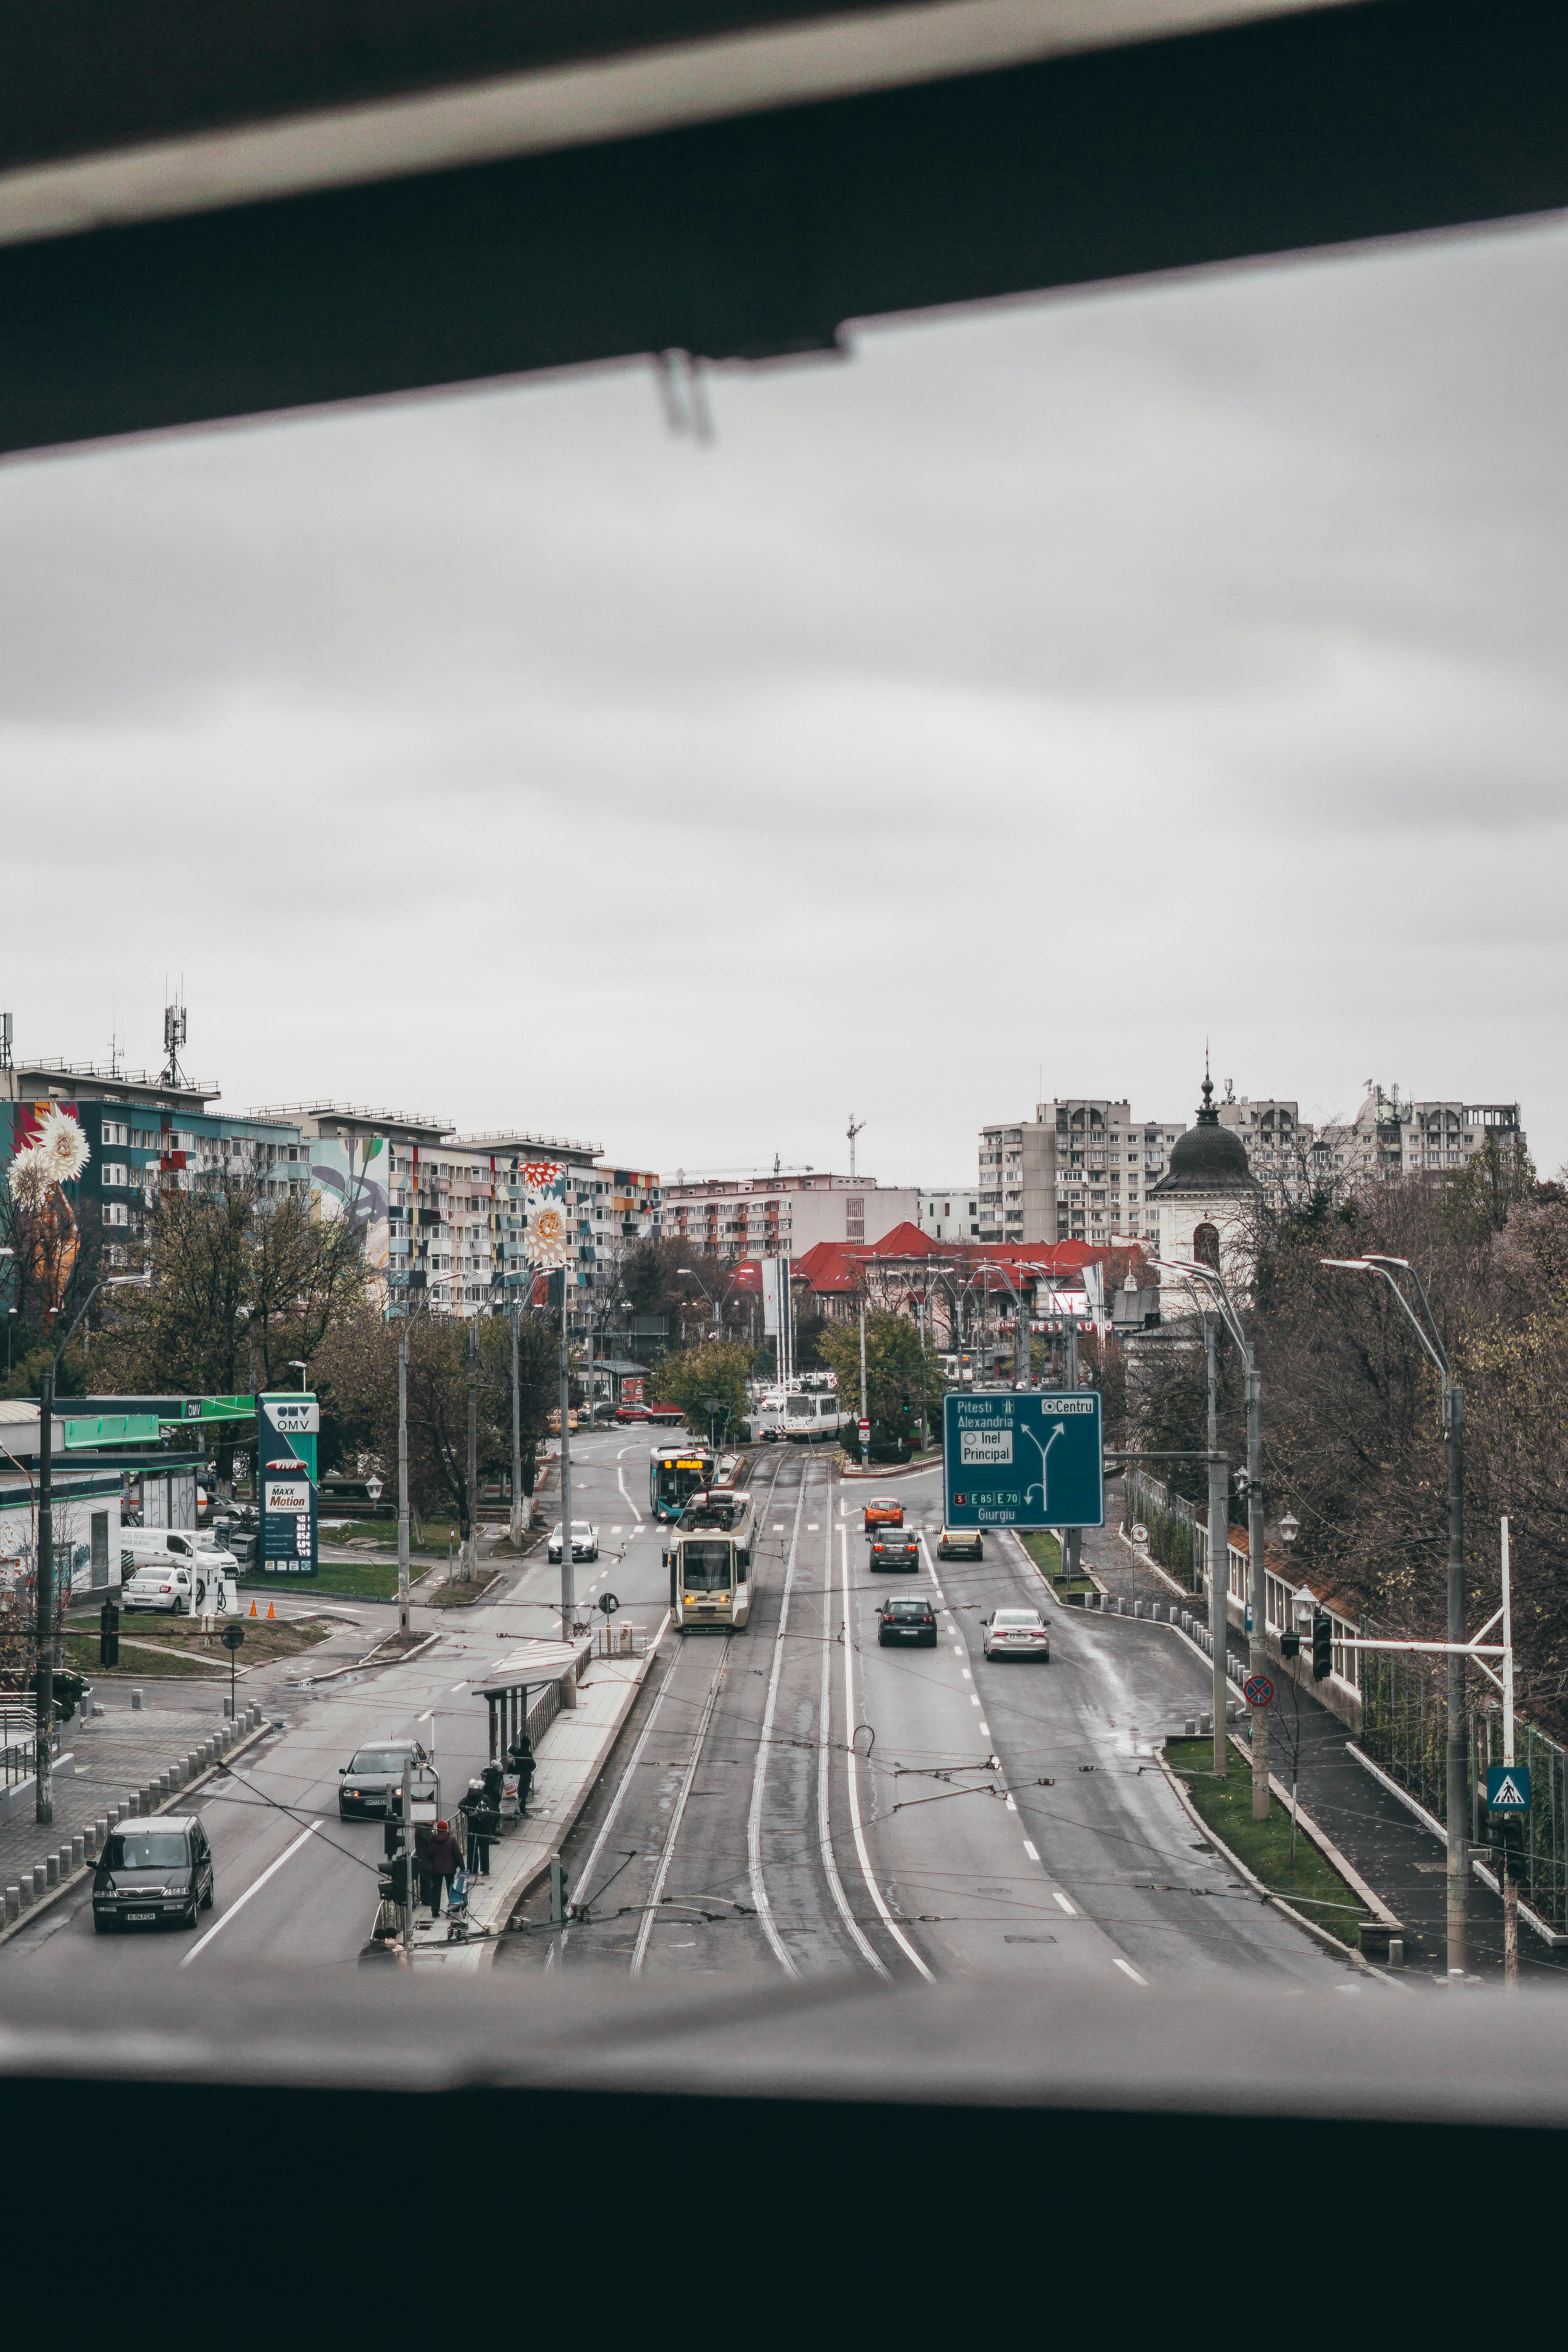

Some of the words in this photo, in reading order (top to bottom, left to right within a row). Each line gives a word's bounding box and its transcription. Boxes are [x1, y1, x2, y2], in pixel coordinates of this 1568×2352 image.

[189, 1404, 200, 1416] OMV
[1056, 1400, 1091, 1412] Centru
[278, 1420, 309, 1430] OMV
[958, 1415, 1013, 1428] Alexandria
[982, 1432, 1000, 1443] Inel
[964, 1447, 1009, 1462] Principal
[276, 1461, 298, 1469] VIVA
[270, 1496, 305, 1506] Motion
[972, 1494, 977, 1504] E
[981, 1494, 991, 1503] 85
[998, 1494, 1003, 1503] E
[1007, 1494, 1017, 1503] 70
[978, 1508, 1014, 1523] Giurgiu
